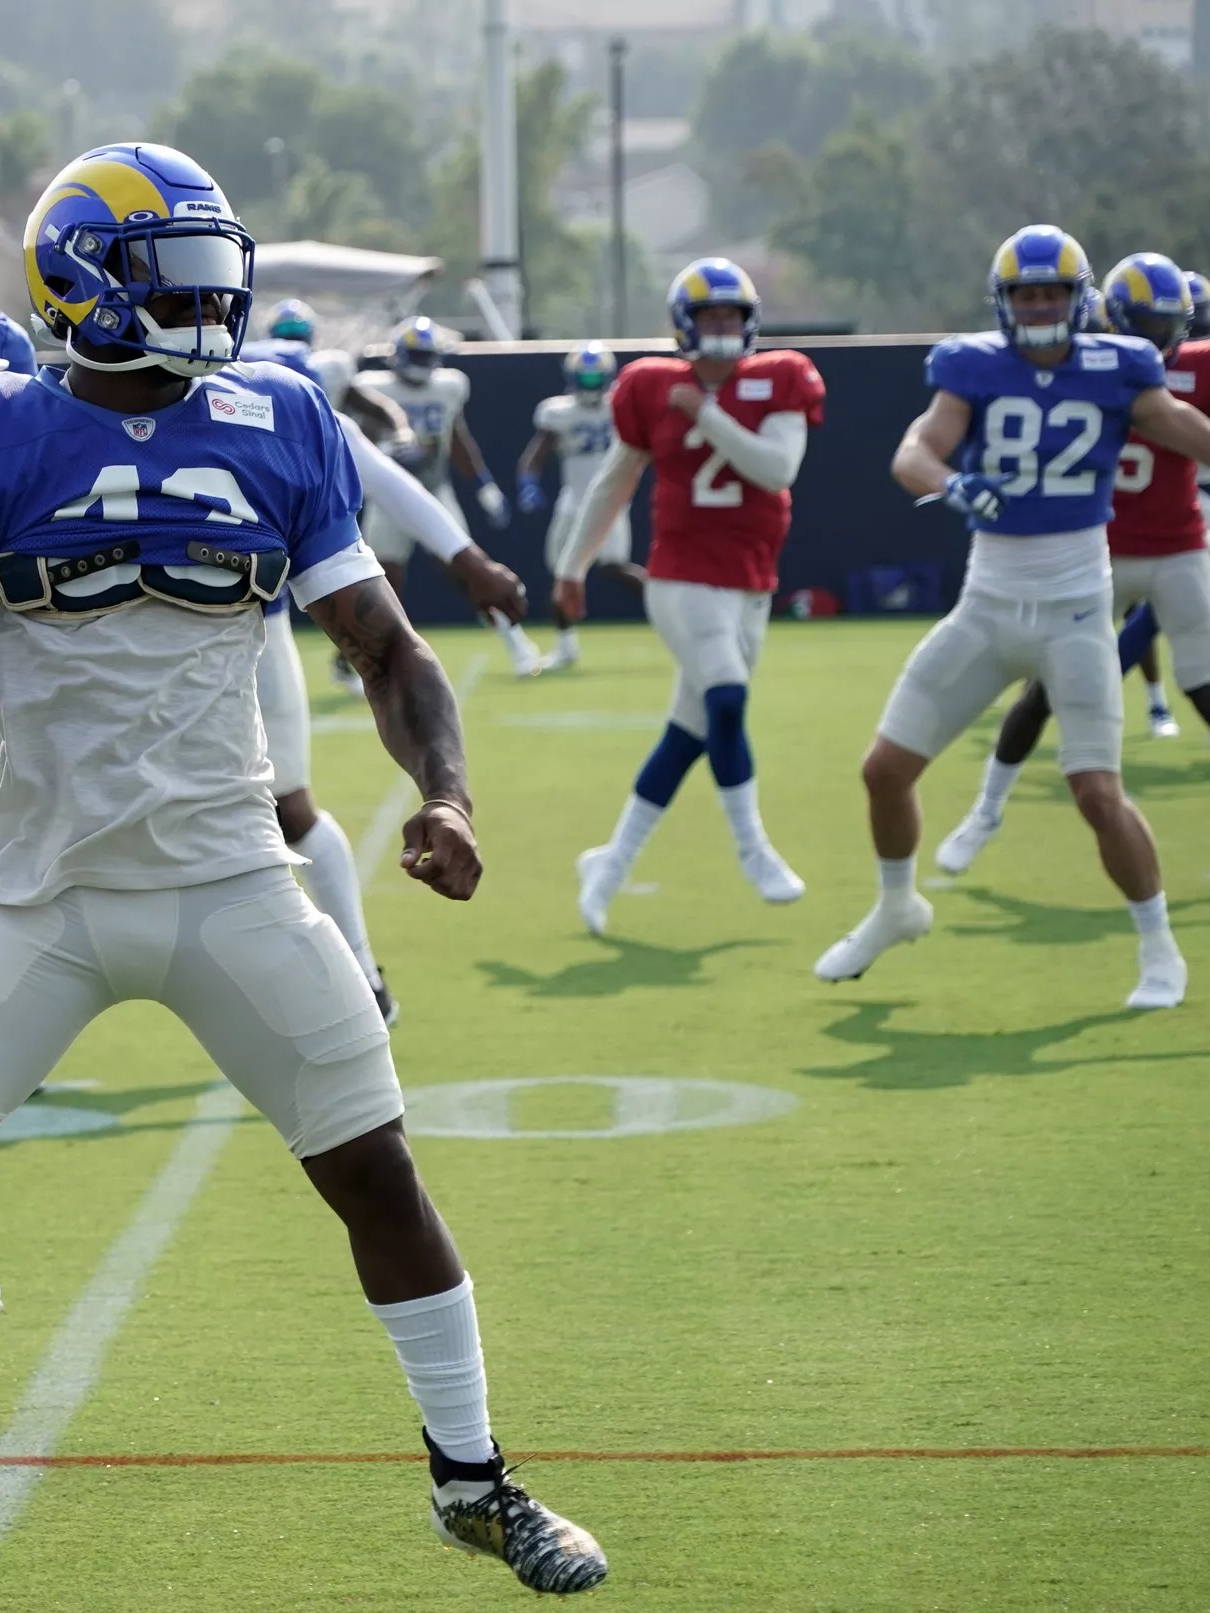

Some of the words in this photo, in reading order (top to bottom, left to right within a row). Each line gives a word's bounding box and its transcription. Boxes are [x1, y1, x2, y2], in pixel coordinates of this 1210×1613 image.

[186, 203, 222, 214] RAMS
[235, 401, 270, 413] Cedars
[983, 396, 1103, 497] 82
